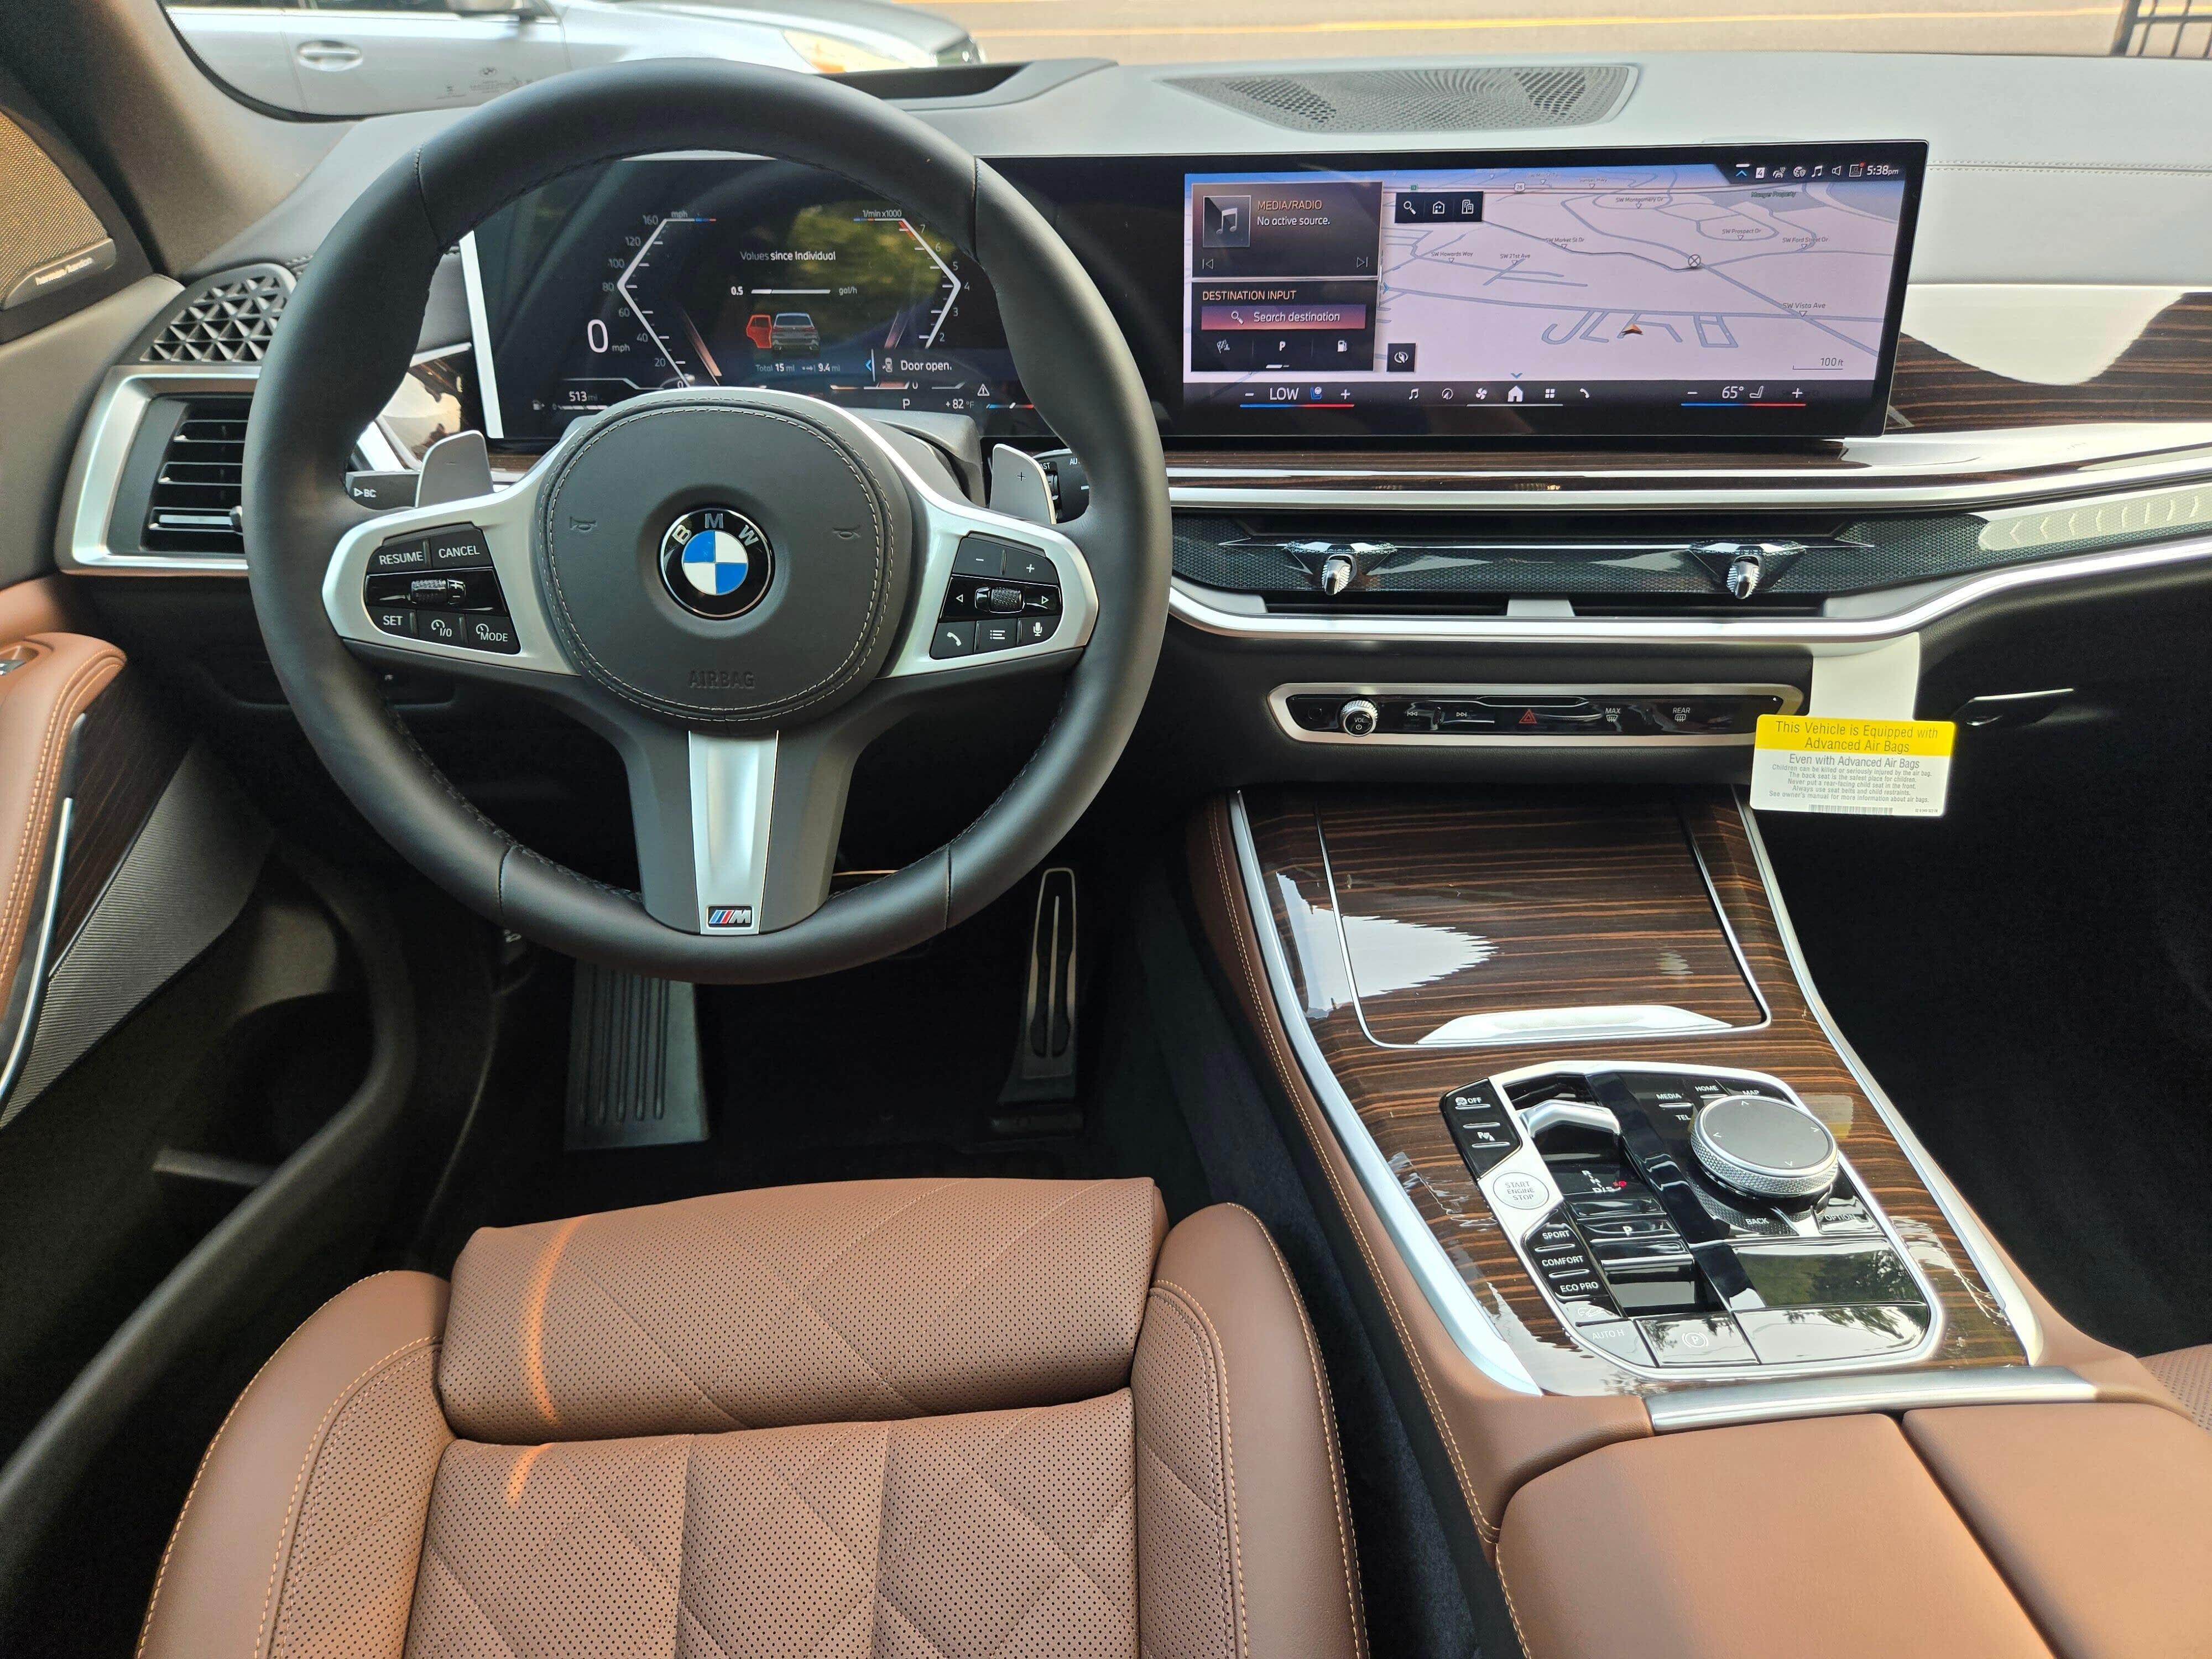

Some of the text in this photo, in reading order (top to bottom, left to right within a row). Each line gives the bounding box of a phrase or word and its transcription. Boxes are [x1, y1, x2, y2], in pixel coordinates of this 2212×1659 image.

[1258, 200, 1322, 210] MEDIA/RADIO
[671, 210, 688, 218] mph
[643, 215, 659, 225] 160
[1257, 216, 1330, 226] No active source.
[920, 224, 926, 233] 7
[625, 236, 641, 247] 120
[936, 242, 941, 252] 6
[740, 250, 836, 260] Values since Individual
[609, 258, 625, 269] 100
[953, 261, 958, 271] 5
[602, 282, 614, 292] 80
[731, 286, 743, 295] 0.5
[838, 286, 857, 296] gal/h
[964, 282, 970, 291] 4
[1202, 290, 1297, 300] DESTINATION INPUT
[618, 307, 630, 317] 60
[953, 307, 958, 317] 3
[1254, 311, 1340, 322] Search destination
[587, 319, 608, 353] 0
[637, 332, 648, 343] 40
[940, 333, 945, 342] 2
[612, 344, 630, 353] mph
[654, 357, 666, 367] 20
[900, 360, 952, 373] Door open.
[1820, 358, 1837, 366] 100
[775, 363, 784, 372] 15
[818, 363, 830, 372] 9.4
[568, 391, 587, 401] 513
[1270, 387, 1299, 400] LOW
[1721, 385, 1744, 399] 65°
[902, 398, 910, 409] P
[672, 513, 759, 546] BMW
[439, 545, 480, 559] CANCEL
[379, 551, 424, 565] RESUME
[383, 615, 403, 626] SET
[481, 632, 508, 642] MODE
[690, 670, 755, 689] AIRBAG
[1775, 721, 1938, 740] This Vehicle is Equipped with
[1804, 737, 1910, 755] Advanced Air Bags
[1790, 753, 1919, 770] Even with Advanced Air Bags
[1542, 1230, 1570, 1239] SPORT
[1623, 1225, 1632, 1236] P
[1542, 1255, 1584, 1267] COMFORT
[1559, 1281, 1599, 1292] ECO PRO
[1592, 1330, 1616, 1340] AUTO
